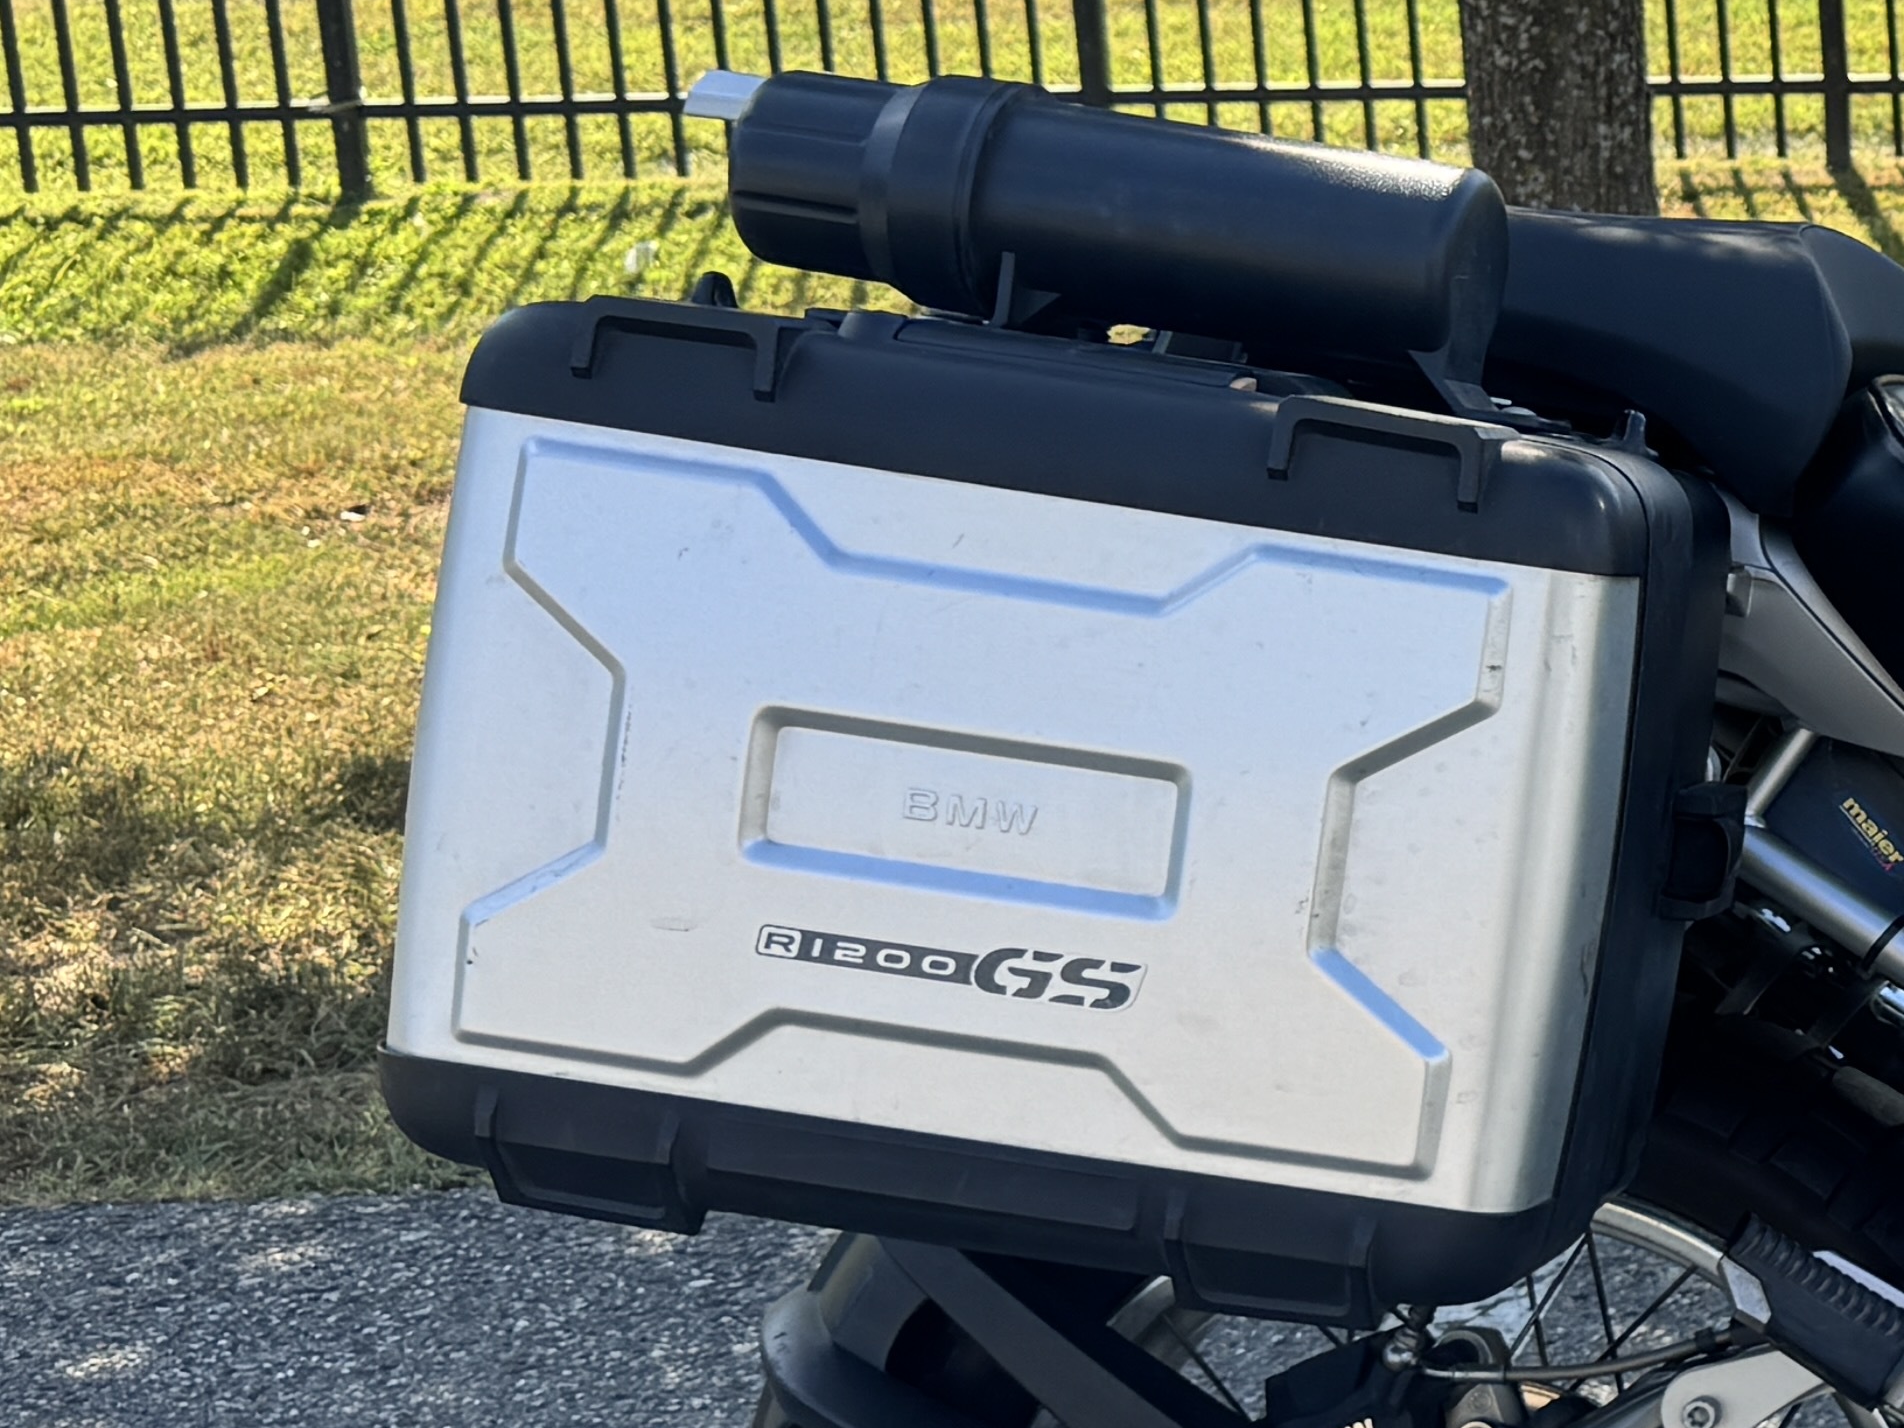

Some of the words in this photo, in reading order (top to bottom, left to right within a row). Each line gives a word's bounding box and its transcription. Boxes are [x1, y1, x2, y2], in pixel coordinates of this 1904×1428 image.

[903, 786, 1039, 836] BMW
[1843, 797, 1904, 862] maier
[974, 948, 1142, 1010] GS
